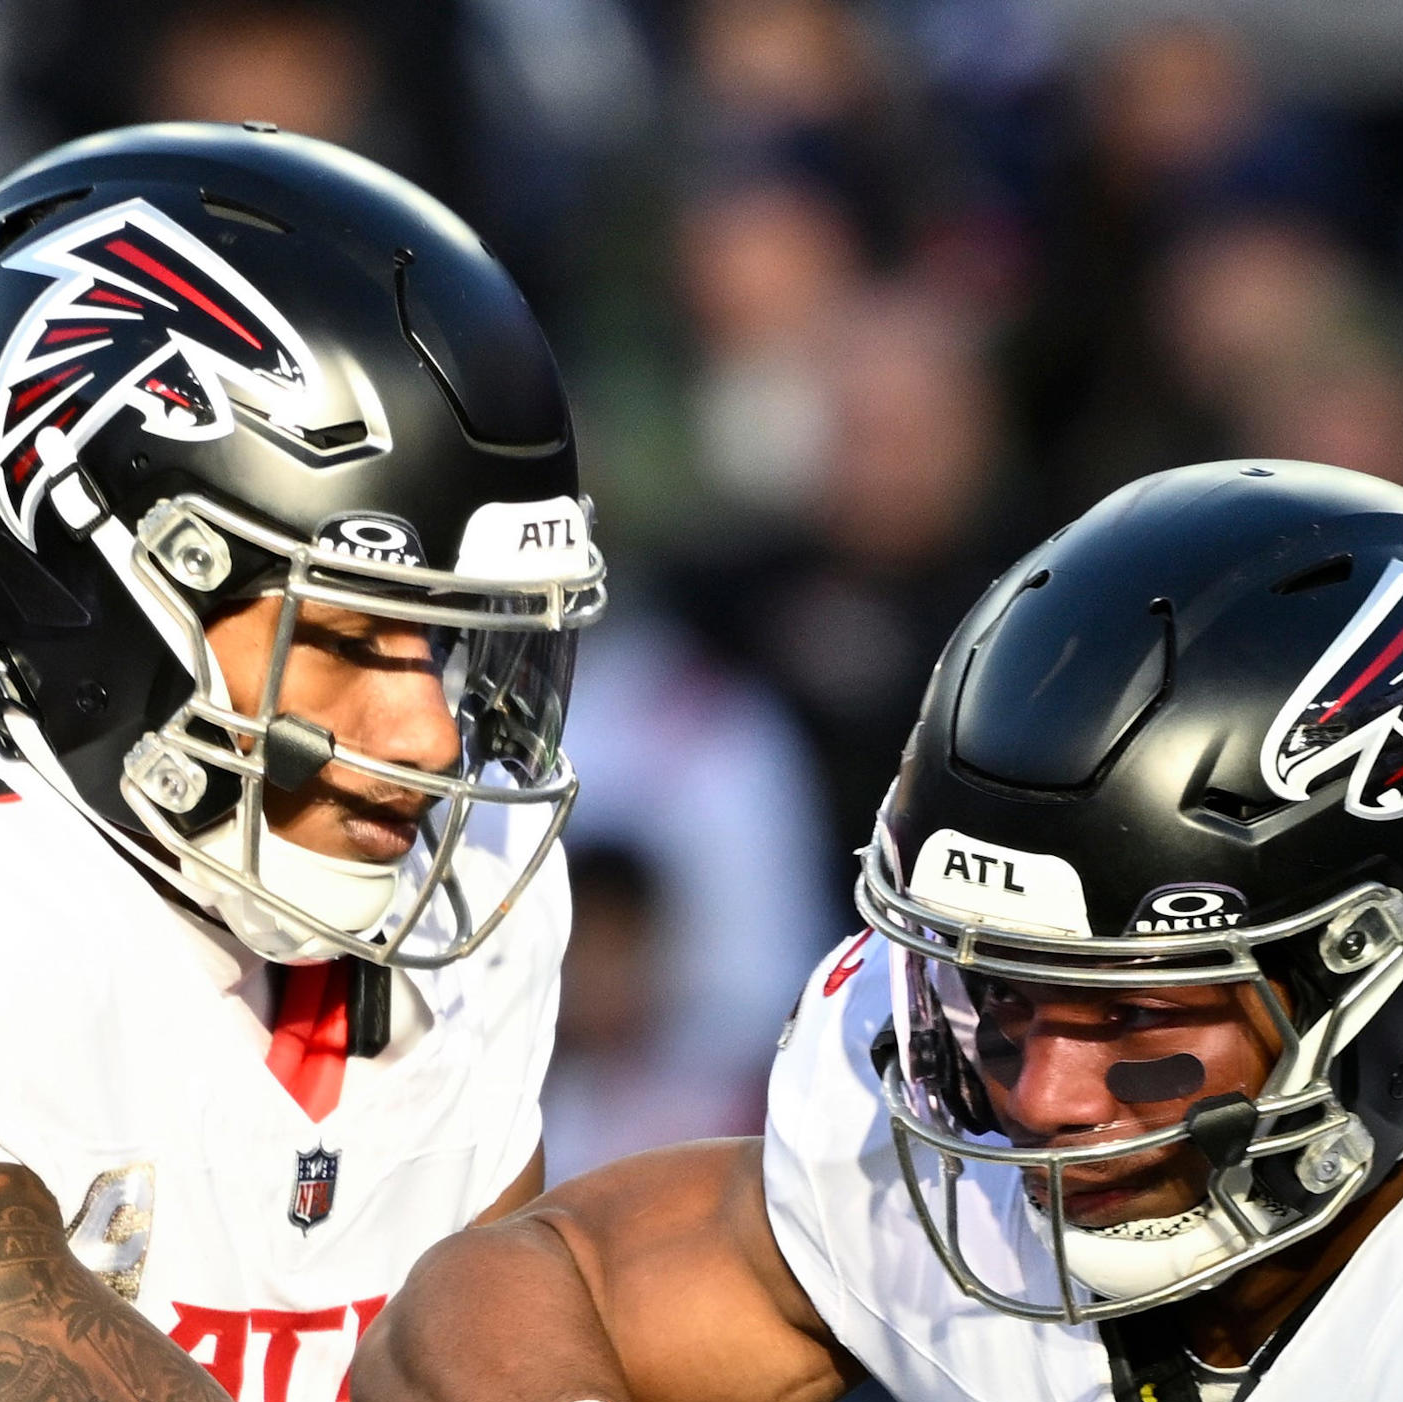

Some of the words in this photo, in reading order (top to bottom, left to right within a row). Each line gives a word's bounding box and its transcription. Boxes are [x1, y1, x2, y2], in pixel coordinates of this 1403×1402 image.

[519, 519, 576, 550] ATL
[944, 849, 1025, 894] ATL
[1135, 913, 1242, 933] OAKLEY
